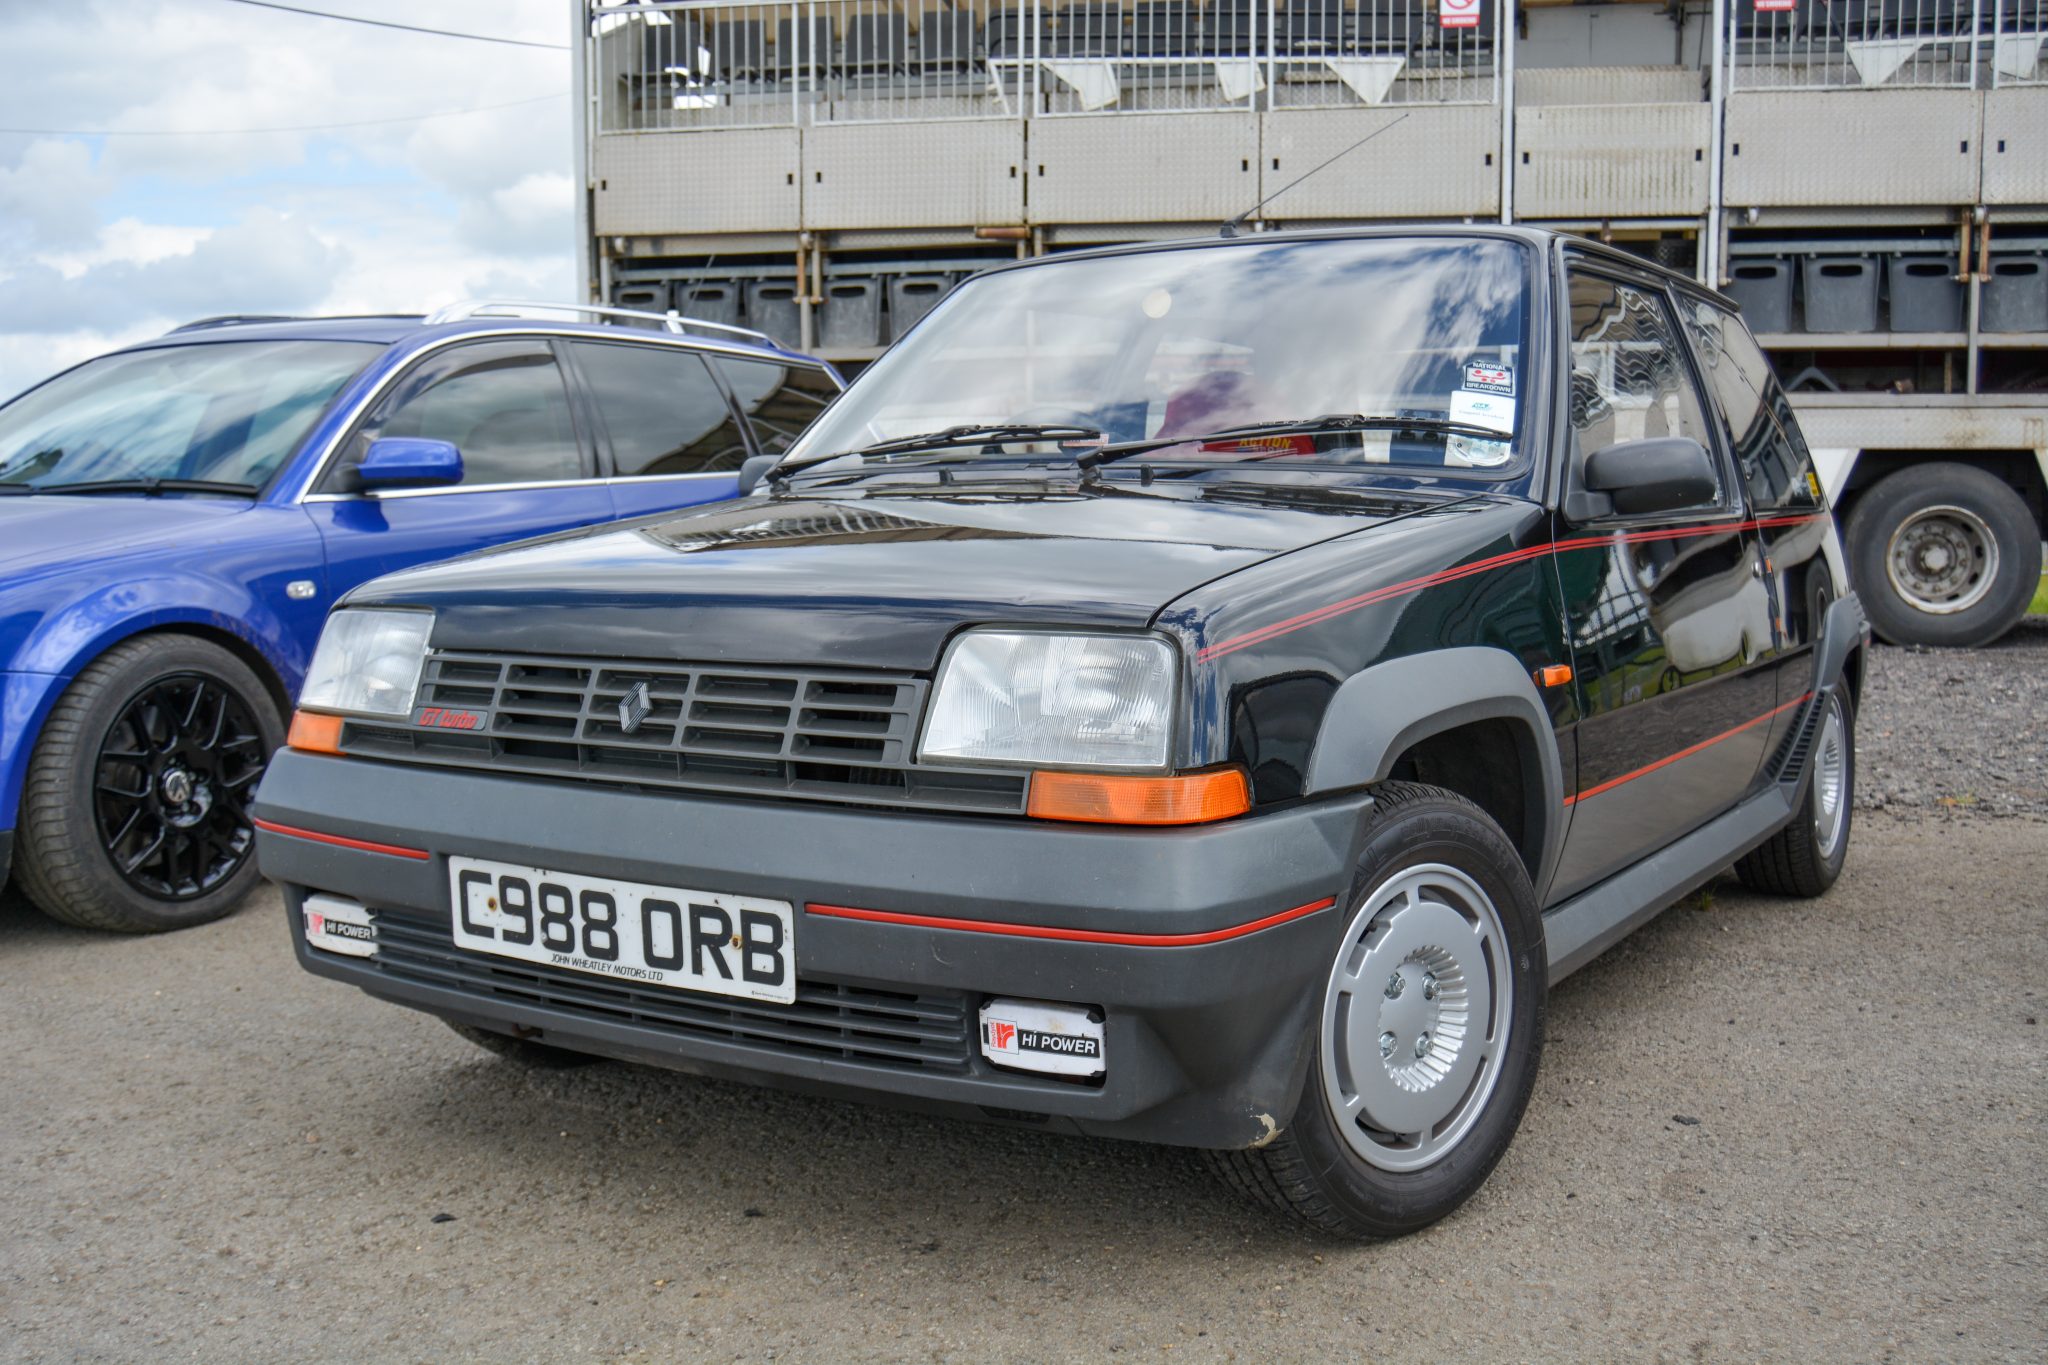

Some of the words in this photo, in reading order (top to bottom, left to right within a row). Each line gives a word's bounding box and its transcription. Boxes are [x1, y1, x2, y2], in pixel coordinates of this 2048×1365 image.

[1472, 362, 1506, 371] NATIONAL
[1466, 382, 1511, 393] BREAKDOWN
[419, 707, 442, 726] GT
[440, 709, 478, 729] turbo
[337, 923, 370, 939] POWER
[458, 869, 619, 962] C988
[640, 898, 785, 987] ORB
[551, 953, 570, 965] JOHN
[571, 958, 612, 973] WHEATLEY
[612, 965, 647, 979] MOTORS
[648, 971, 664, 981] LTD
[1041, 1036, 1096, 1055] POWER
